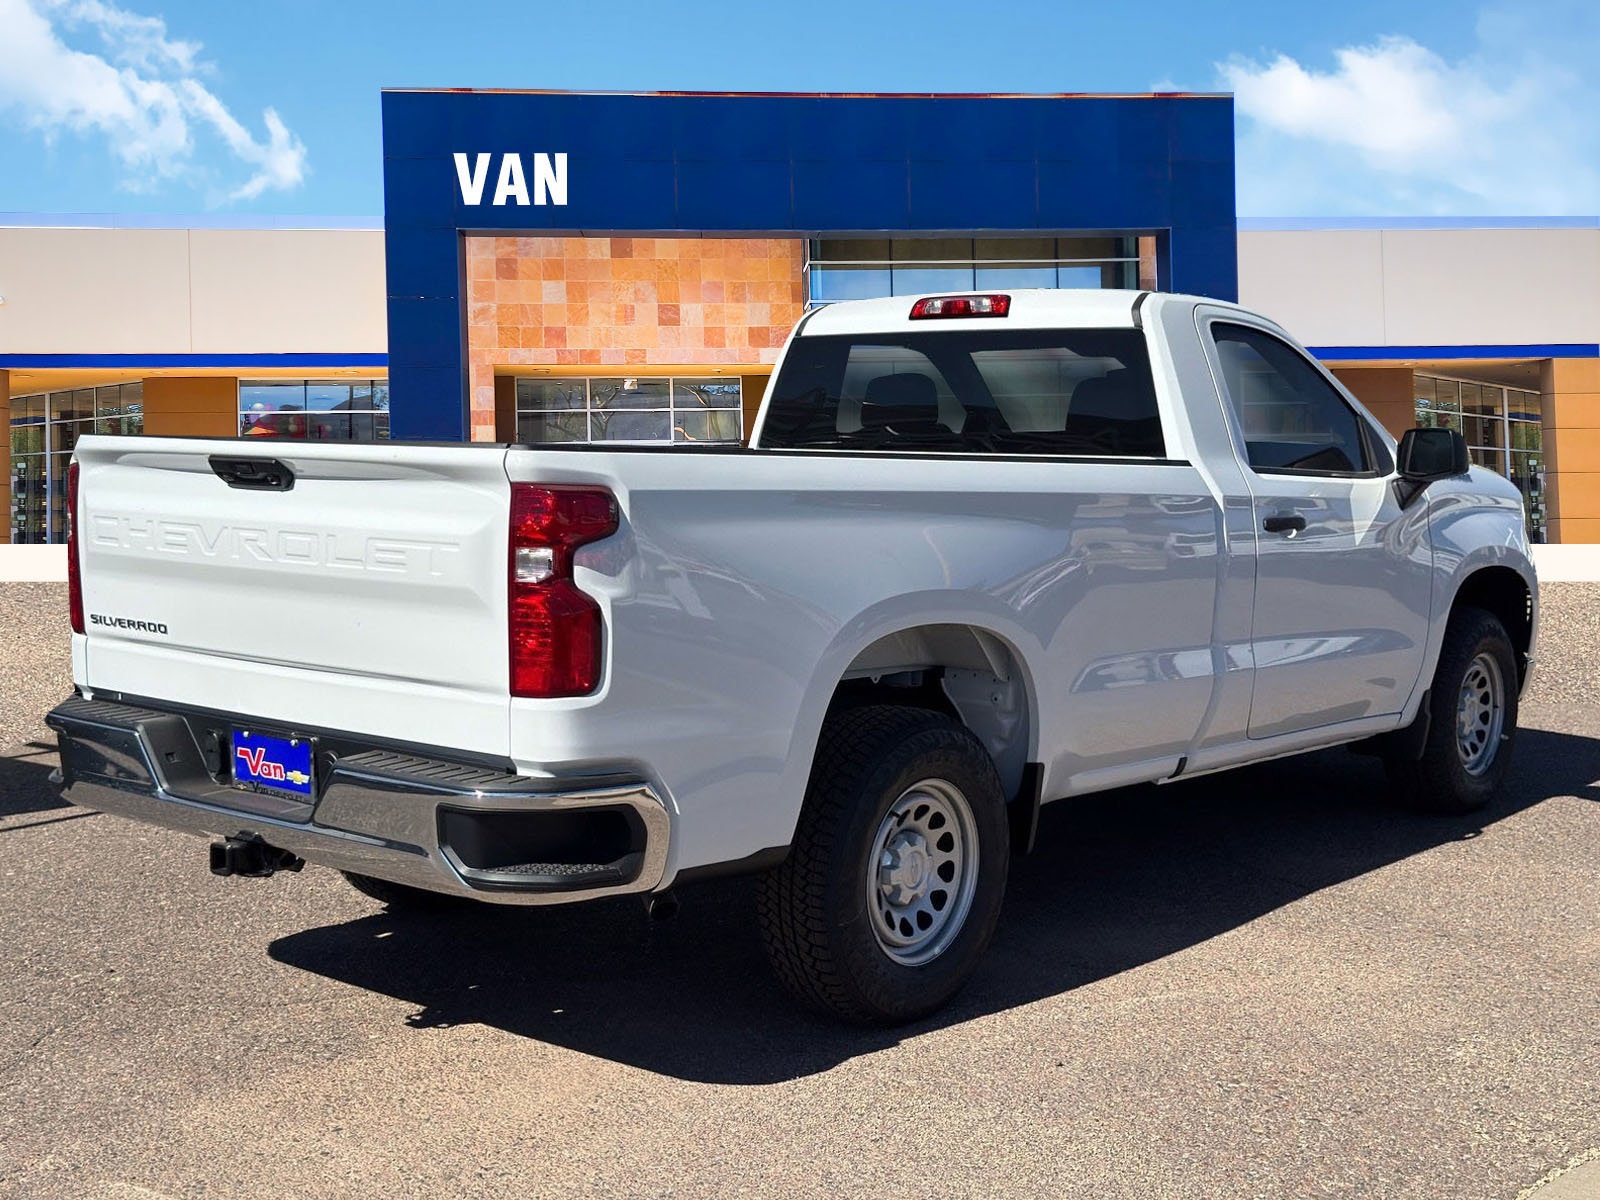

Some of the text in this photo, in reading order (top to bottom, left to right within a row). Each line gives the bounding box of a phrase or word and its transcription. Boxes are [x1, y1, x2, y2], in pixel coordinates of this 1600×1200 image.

[453, 152, 568, 206] VAN
[92, 514, 461, 576] CHEVROLET
[90, 613, 169, 635] SILVERADO
[237, 747, 286, 781] Van
